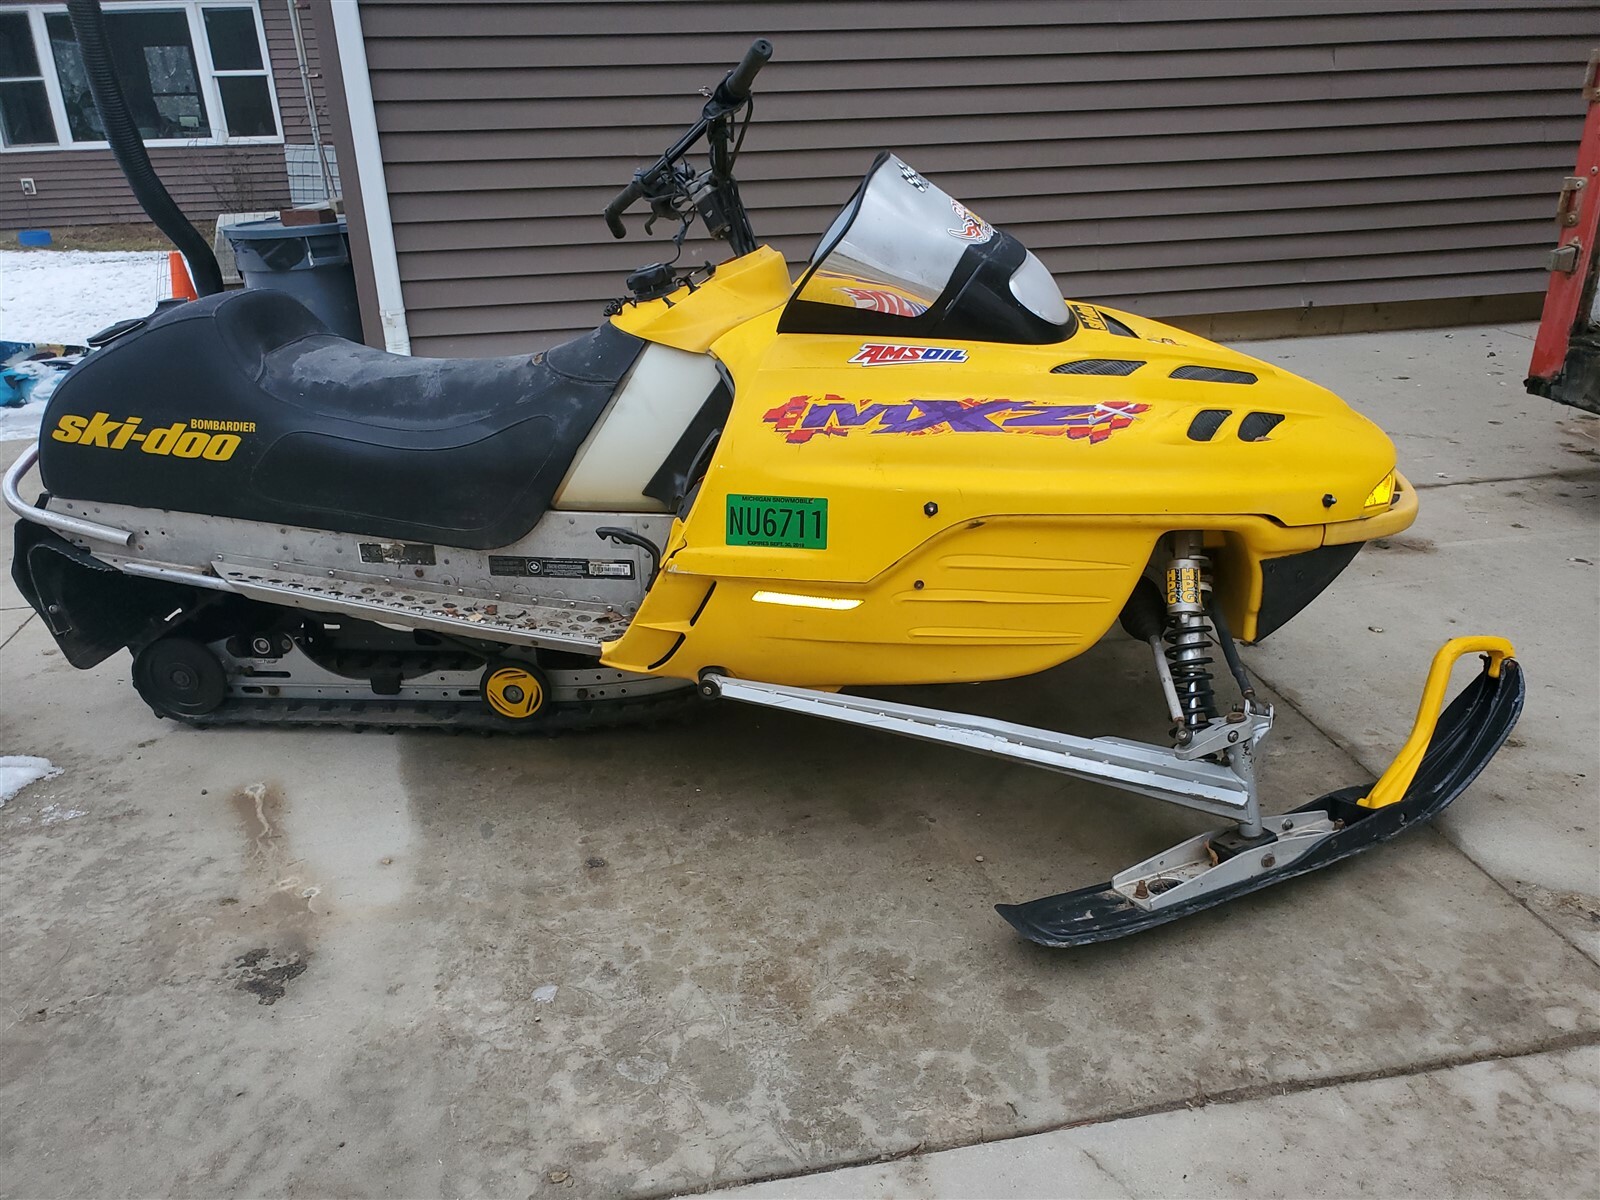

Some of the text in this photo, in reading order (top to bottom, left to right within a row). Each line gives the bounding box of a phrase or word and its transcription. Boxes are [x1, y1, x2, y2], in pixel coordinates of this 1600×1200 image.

[855, 345, 966, 363] AMSOIL
[51, 411, 242, 462] ski-doo
[190, 418, 256, 433] BOMBARDIER
[729, 506, 822, 539] NU6711
[1181, 568, 1195, 603] HPG
